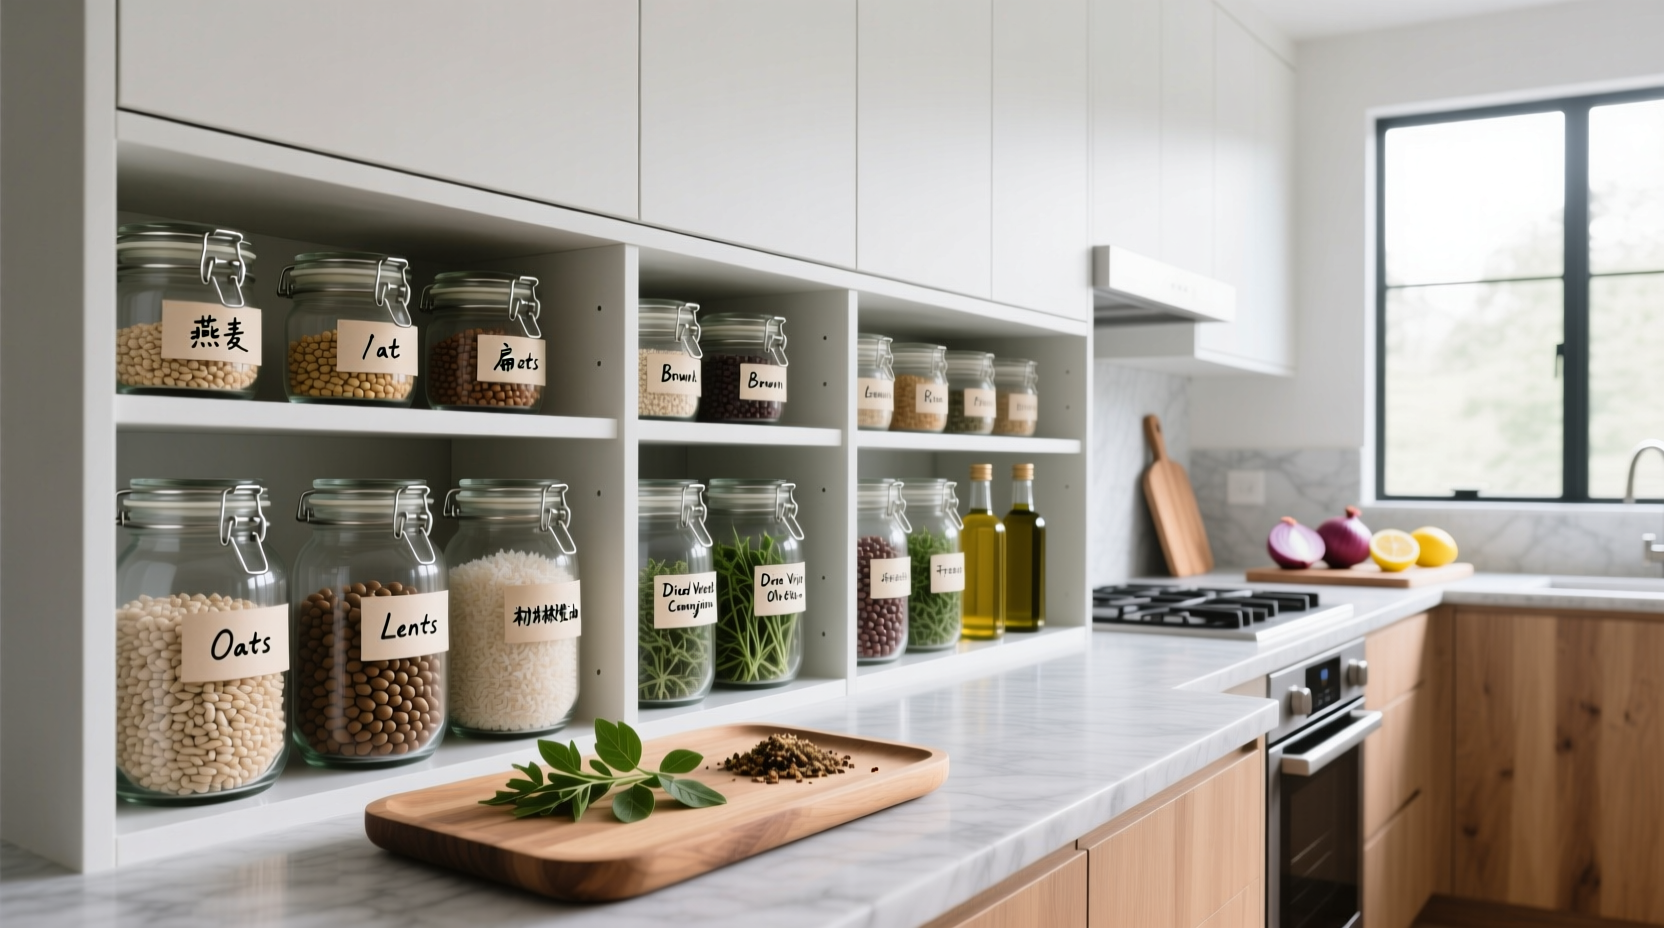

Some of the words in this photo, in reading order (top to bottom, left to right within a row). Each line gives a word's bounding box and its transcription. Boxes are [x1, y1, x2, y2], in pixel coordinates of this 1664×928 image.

[190, 314, 249, 353] 燕麦
[380, 611, 437, 640] Lents
[210, 628, 271, 661] Oats
